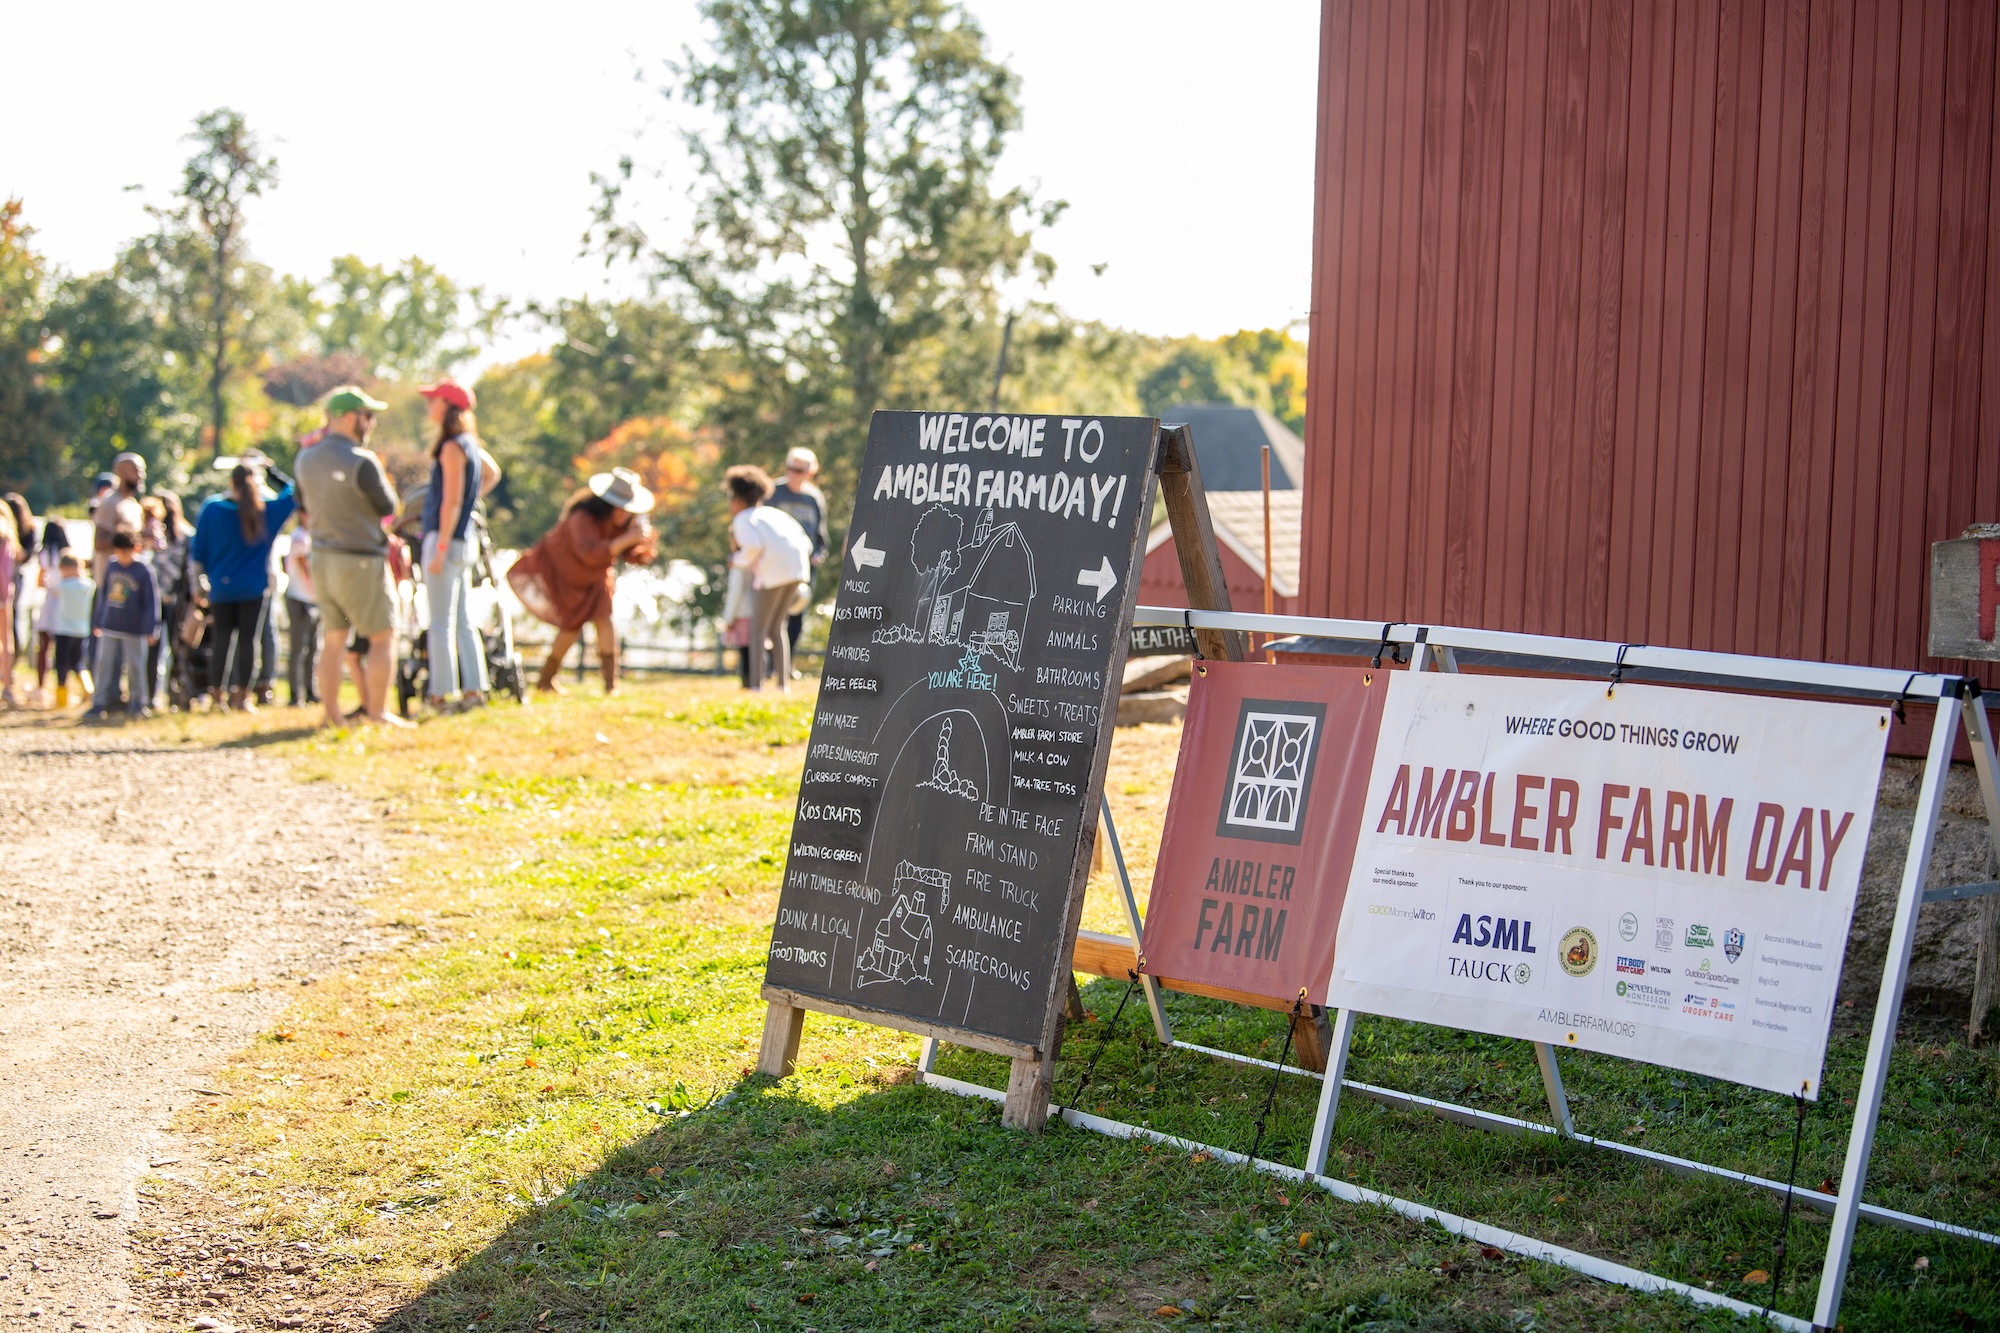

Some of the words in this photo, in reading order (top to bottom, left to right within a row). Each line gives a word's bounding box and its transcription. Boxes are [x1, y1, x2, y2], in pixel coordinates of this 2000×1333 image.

[919, 414, 1046, 458] WELCOME
[1062, 418, 1105, 463] TO
[874, 463, 971, 506] AMBLER
[976, 470, 1047, 510] FARM
[1048, 471, 1127, 529] DAY!
[844, 580, 871, 594] MUSIC
[835, 607, 851, 621] KIDS
[853, 606, 883, 621] CRAFTS
[1052, 595, 1107, 619] PARKING
[1046, 630, 1098, 651] ANIMALS
[832, 645, 870, 663] HAYRIDES
[824, 675, 846, 691] APPLE
[849, 678, 877, 692] PEELER
[928, 672, 948, 690] YOU
[946, 670, 963, 688] ARE
[966, 672, 998, 692] HERE!
[1036, 667, 1101, 690] BATHROOMS
[817, 711, 834, 727] HAY
[834, 714, 859, 729] MAZE
[1007, 693, 1050, 718] SWEETS
[1059, 701, 1099, 727] TREATS
[1011, 727, 1036, 740] AMBLER
[1037, 730, 1056, 742] FARM
[1058, 731, 1084, 744] STORE
[1506, 715, 1557, 736] WHERE
[1558, 718, 1616, 741] GOOD
[1620, 724, 1679, 748] THINGS
[1682, 730, 1740, 755] GROW
[810, 744, 835, 760] APPLE
[835, 746, 880, 766] SLINGSHOT
[1013, 750, 1035, 764] MILK
[1037, 755, 1044, 764] A
[1046, 753, 1071, 767] COW
[805, 769, 841, 785] CURBSIDE
[845, 773, 879, 788] COMPOST
[1054, 781, 1077, 796] TOSS
[799, 797, 821, 822] KIDS
[822, 805, 862, 827] CRAFTS
[978, 802, 997, 823] PIE
[998, 807, 1009, 826] IN
[1011, 810, 1030, 830] THE
[1035, 815, 1064, 837] FACE
[1376, 764, 1580, 855] AMBLER
[1596, 783, 1734, 877] FARM
[1745, 802, 1855, 892] DAY
[794, 843, 822, 859] WILTON
[821, 847, 834, 860] GO
[833, 848, 863, 863] GREEN
[965, 832, 995, 859] FARM
[998, 842, 1038, 871] STAND
[1205, 857, 1296, 902] AMBLER
[1374, 867, 1391, 875] Special
[1392, 869, 1408, 877] thanks
[788, 870, 808, 889] HAY
[810, 873, 843, 895] TUMBLE
[845, 880, 881, 906] GROUND
[966, 868, 993, 893] FIRE
[999, 879, 1039, 913] TRUCK
[1459, 877, 1474, 886] Thank
[1502, 883, 1528, 892] sponsors:
[780, 908, 807, 931] DUNK
[811, 913, 818, 932] A
[821, 914, 853, 939] LOCAL
[952, 904, 1022, 943] AMBULANCE
[1193, 898, 1287, 962] FARM
[1452, 913, 1537, 954] ASML
[770, 941, 792, 962] FOOD
[791, 947, 827, 968] TRUCKS
[1617, 956, 1628, 966] FIT
[1628, 958, 1646, 968] BODY
[945, 944, 1030, 991] SCARECROWS
[1449, 957, 1513, 984] TAUCK
[1616, 965, 1630, 973] BOOT
[1630, 966, 1645, 975] CAMP
[1650, 966, 1671, 974] WILTON
[1685, 968, 1706, 979] Outdoor
[1706, 972, 1722, 982] Sports
[1723, 975, 1739, 985] Center
[1626, 992, 1670, 1005] MONTESSORI
[1538, 1009, 1636, 1038] AMBLERFARM.ORG
[1682, 1006, 1712, 1018] URGENT
[1714, 1011, 1734, 1022] CARE
